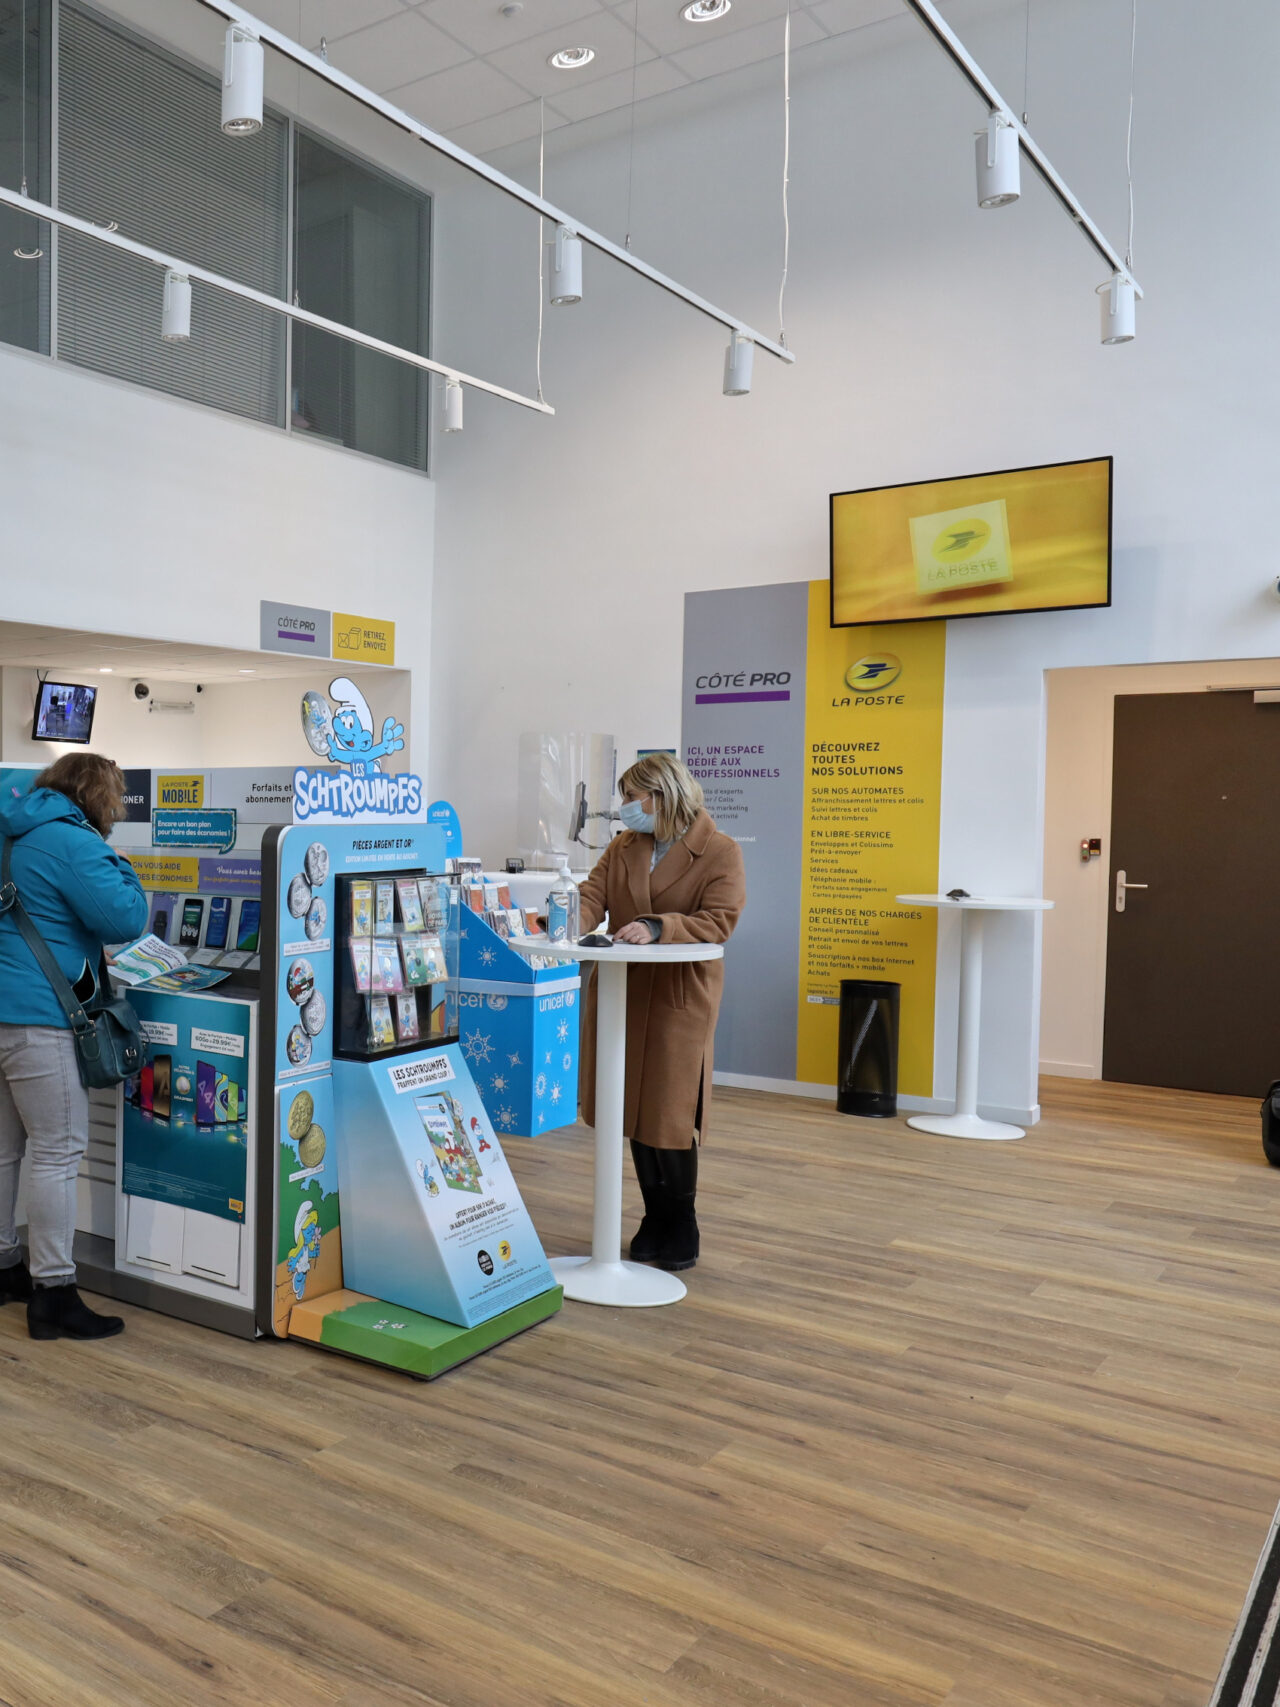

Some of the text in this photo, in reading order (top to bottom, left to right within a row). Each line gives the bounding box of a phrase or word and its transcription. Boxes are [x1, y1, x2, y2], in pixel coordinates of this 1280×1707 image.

[278, 616, 316, 632] CÔTÉ PRO
[364, 640, 387, 651] ENVOYEZ
[695, 671, 792, 690] CÔTÉ PRO
[832, 695, 905, 708] LA POSTE
[688, 745, 765, 756] ICI, UN ESPACE
[812, 741, 880, 753] DÉCOUVREZ
[687, 756, 741, 766] DÉDIÉ AUX
[812, 754, 856, 764] TOUTES
[352, 762, 366, 777] LES
[812, 766, 904, 776] NOS SOLUTIONS
[252, 784, 292, 792] Forfaits et
[294, 770, 421, 816] SCHTROUMPFS
[852, 787, 904, 795] AUTOMATES
[158, 820, 176, 828] Encore
[186, 820, 198, 828] bon
[198, 820, 212, 829] plan
[172, 828, 185, 836] faire
[811, 830, 892, 839] EN LIBRE-SERVICE
[374, 839, 395, 850] ARGENT
[396, 838, 403, 848] ET
[810, 840, 849, 848] Enveloppes
[810, 848, 861, 856] Prêt-à-envoyer
[144, 862, 163, 870] VOUS
[164, 862, 181, 870] AIDE
[216, 866, 232, 874] Vous
[810, 866, 828, 874] Idées
[810, 876, 847, 884] Téléphonie
[808, 906, 922, 920] AUPRÈS DE NOS CHARGÉS
[808, 916, 869, 926] DE CLIENTÈLE
[808, 926, 880, 936] Conseil personnalisé
[808, 952, 850, 962] Souscription
[886, 957, 914, 965] Internet
[862, 964, 886, 972] mobile
[445, 991, 484, 1008] nicef
[540, 992, 564, 1012] unicef
[393, 1058, 448, 1080] LES SCHTROUMPFS
[397, 1080, 418, 1089] FRAPPENT
[425, 1074, 438, 1082] GRAND
[438, 1072, 448, 1080] COUP
